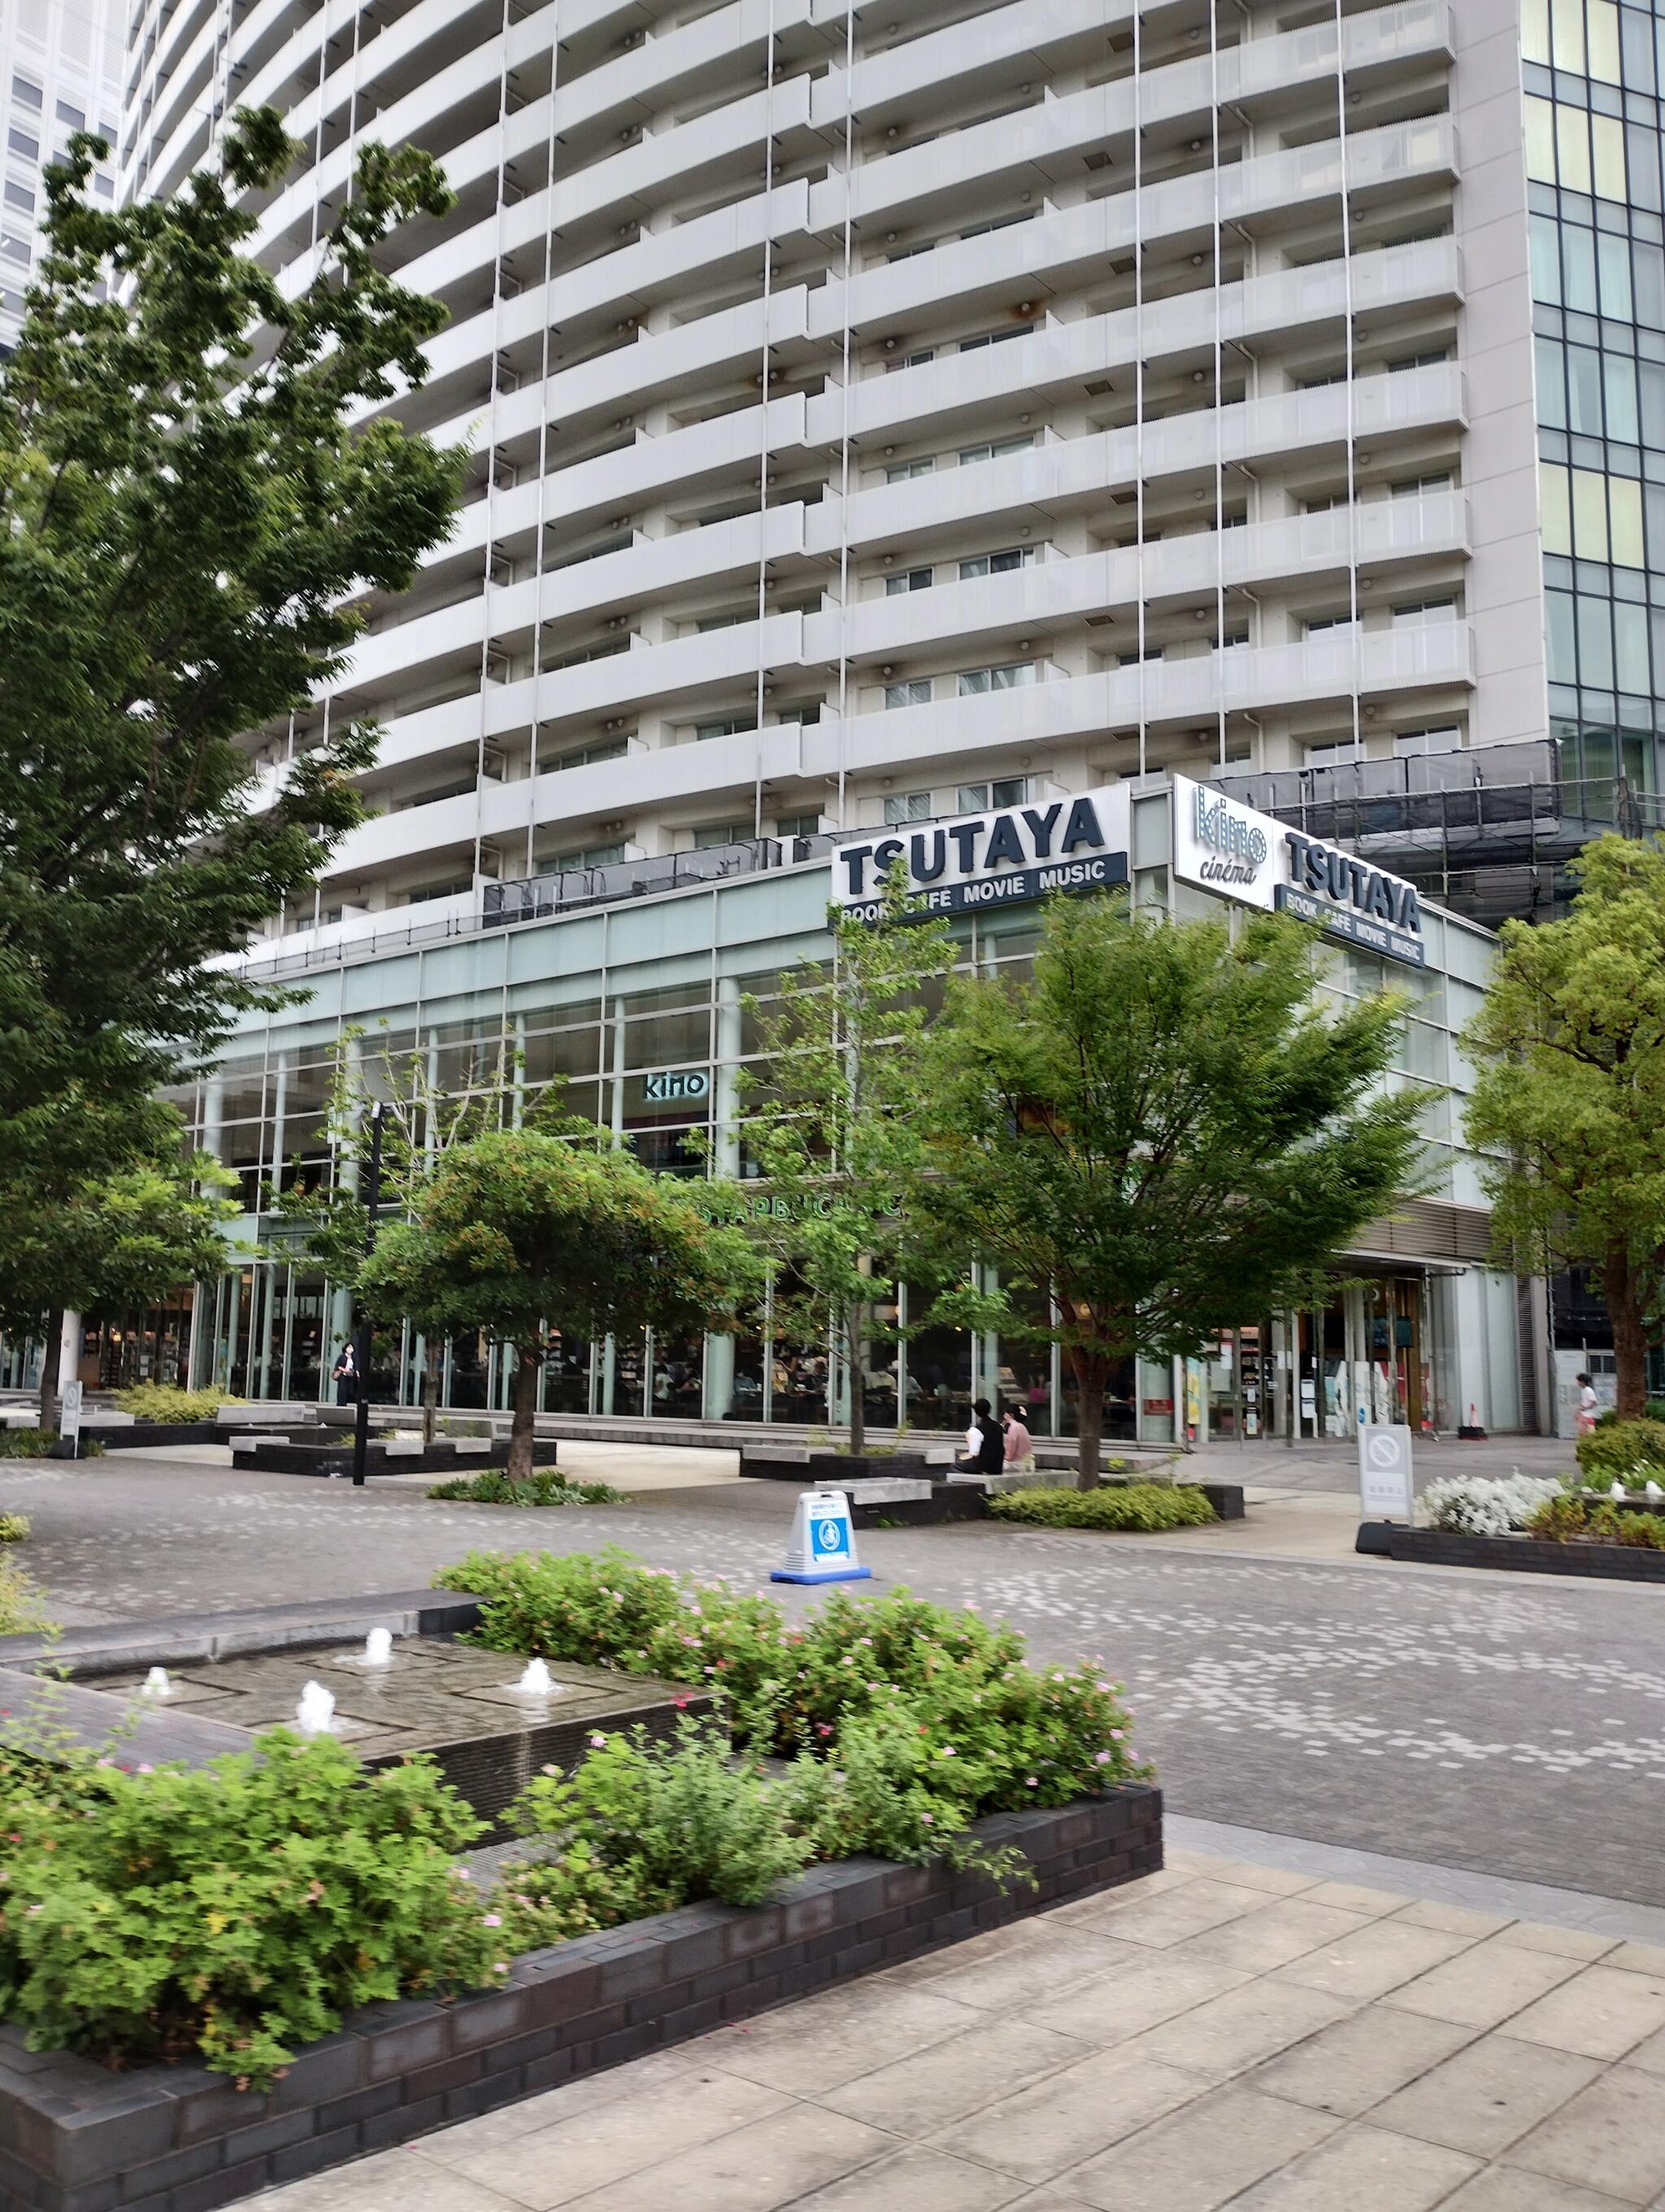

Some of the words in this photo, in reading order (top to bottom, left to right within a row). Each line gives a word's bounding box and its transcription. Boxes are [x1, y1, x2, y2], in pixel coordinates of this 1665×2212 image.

[841, 797, 1106, 895] TSUTAYA
[1197, 785, 1267, 864] kino
[963, 876, 1025, 904] MOVIE
[1039, 860, 1106, 889] MUSIC
[1200, 856, 1258, 885] cinéma
[1285, 832, 1422, 933] TSUTAYA
[1286, 892, 1318, 917] BOOK
[1390, 936, 1421, 961] MUSIC
[642, 1071, 706, 1100] kino
